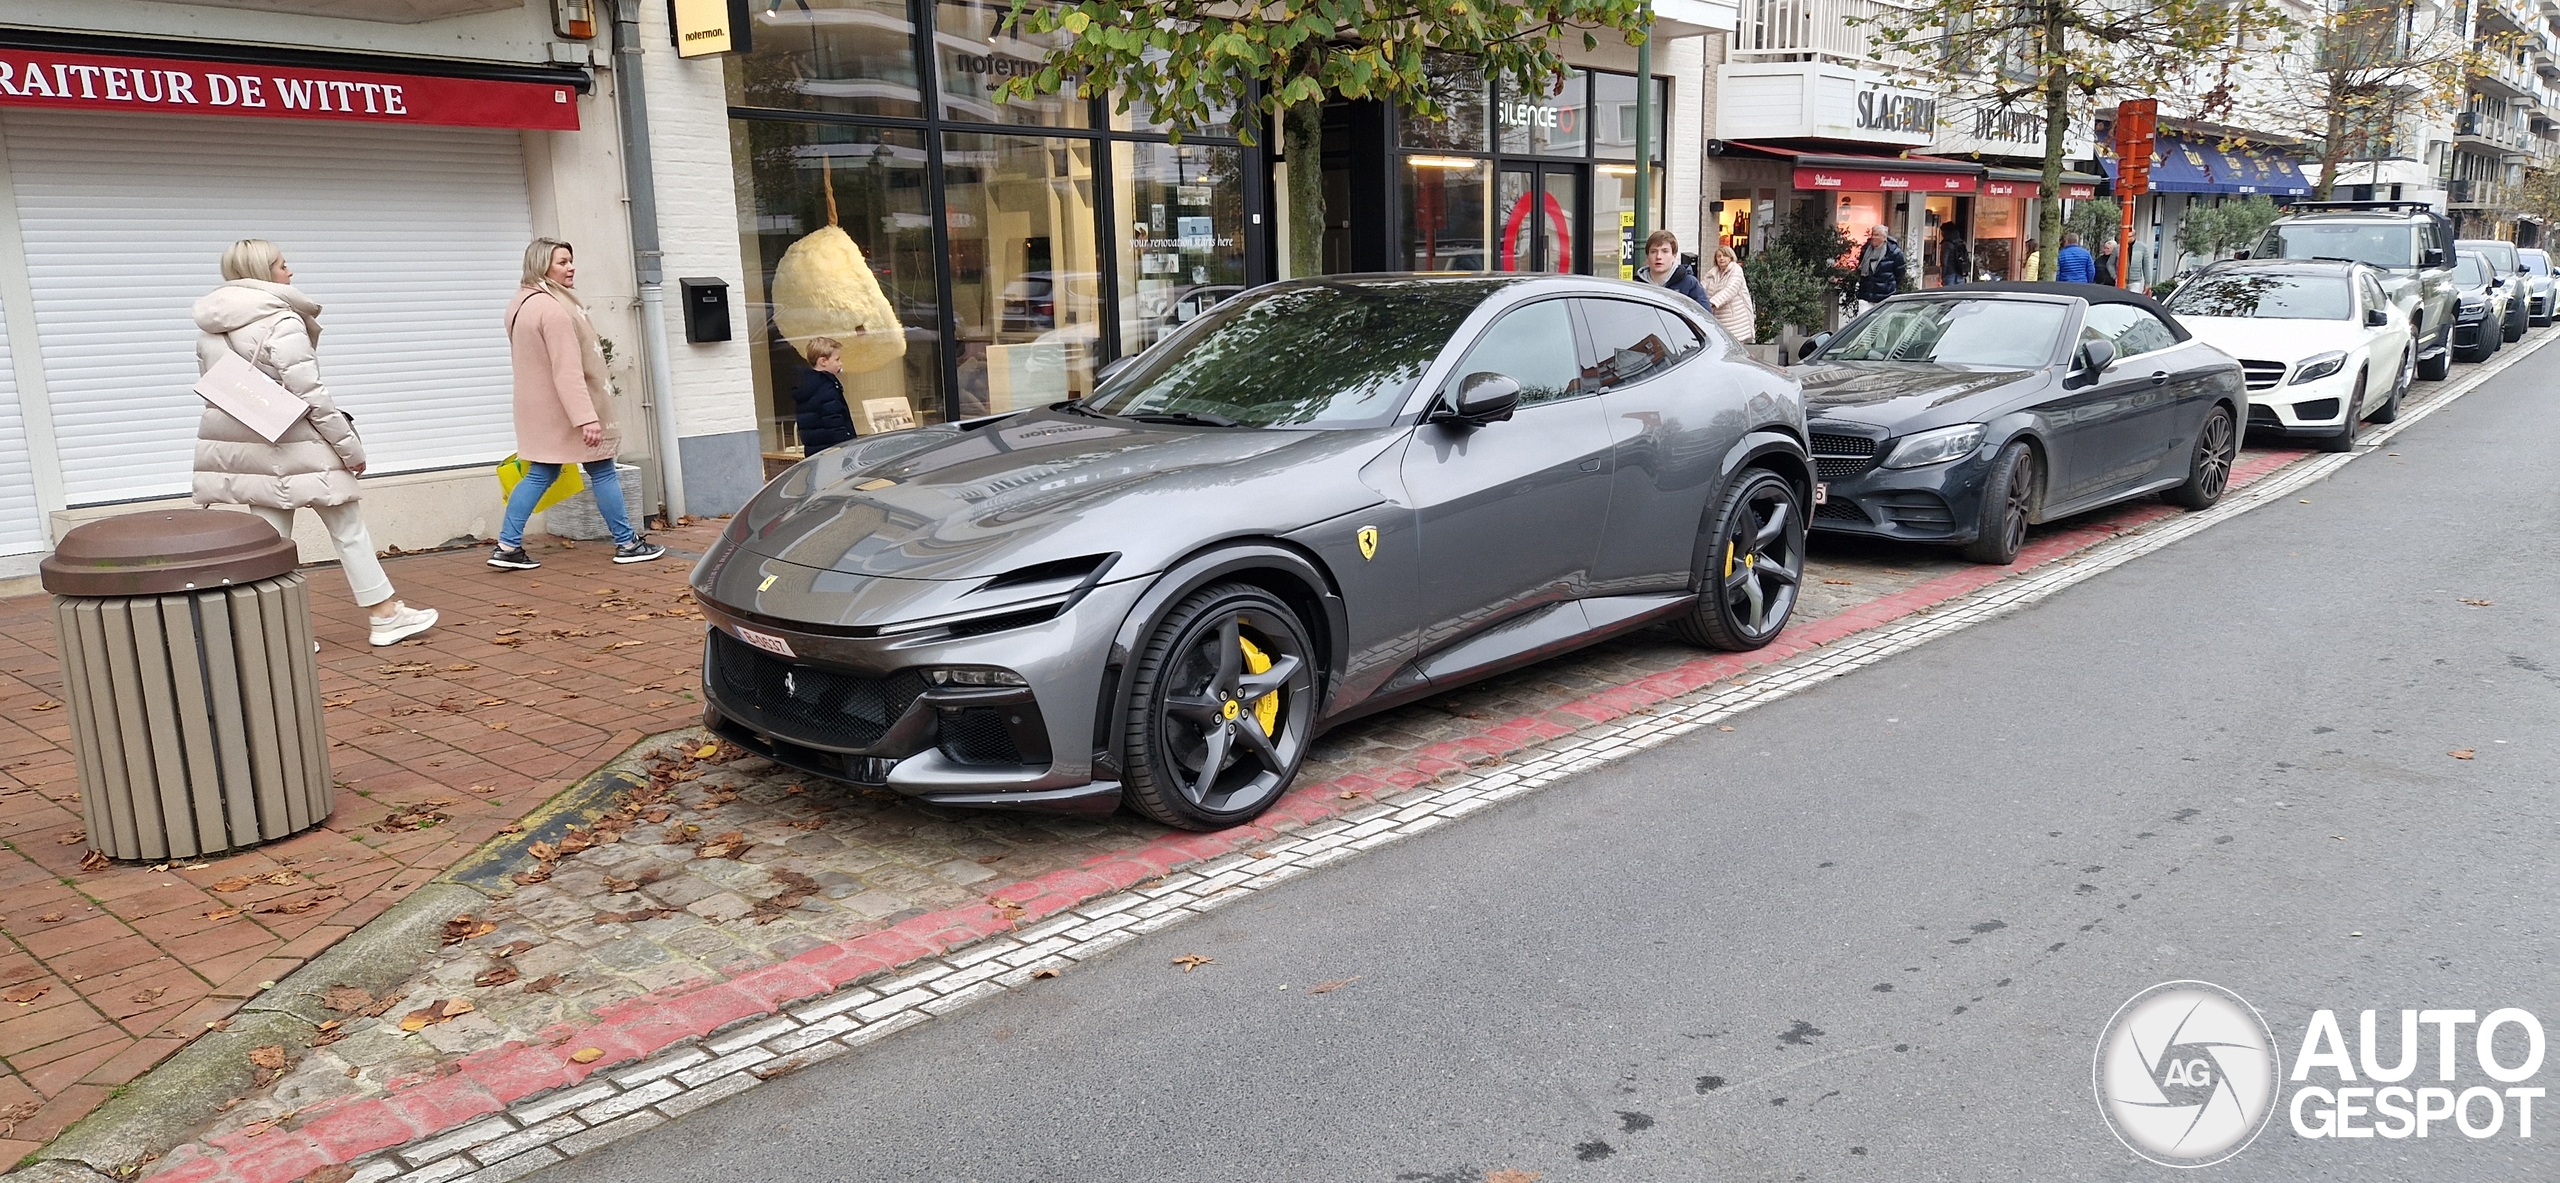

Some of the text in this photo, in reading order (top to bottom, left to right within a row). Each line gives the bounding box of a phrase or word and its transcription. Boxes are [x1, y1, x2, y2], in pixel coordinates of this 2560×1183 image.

[685, 28, 725, 41] noterman.
[204, 72, 266, 108] DE
[273, 77, 407, 114] WITTE
[1975, 107, 1995, 140] DE
[1217, 233, 1234, 248] here
